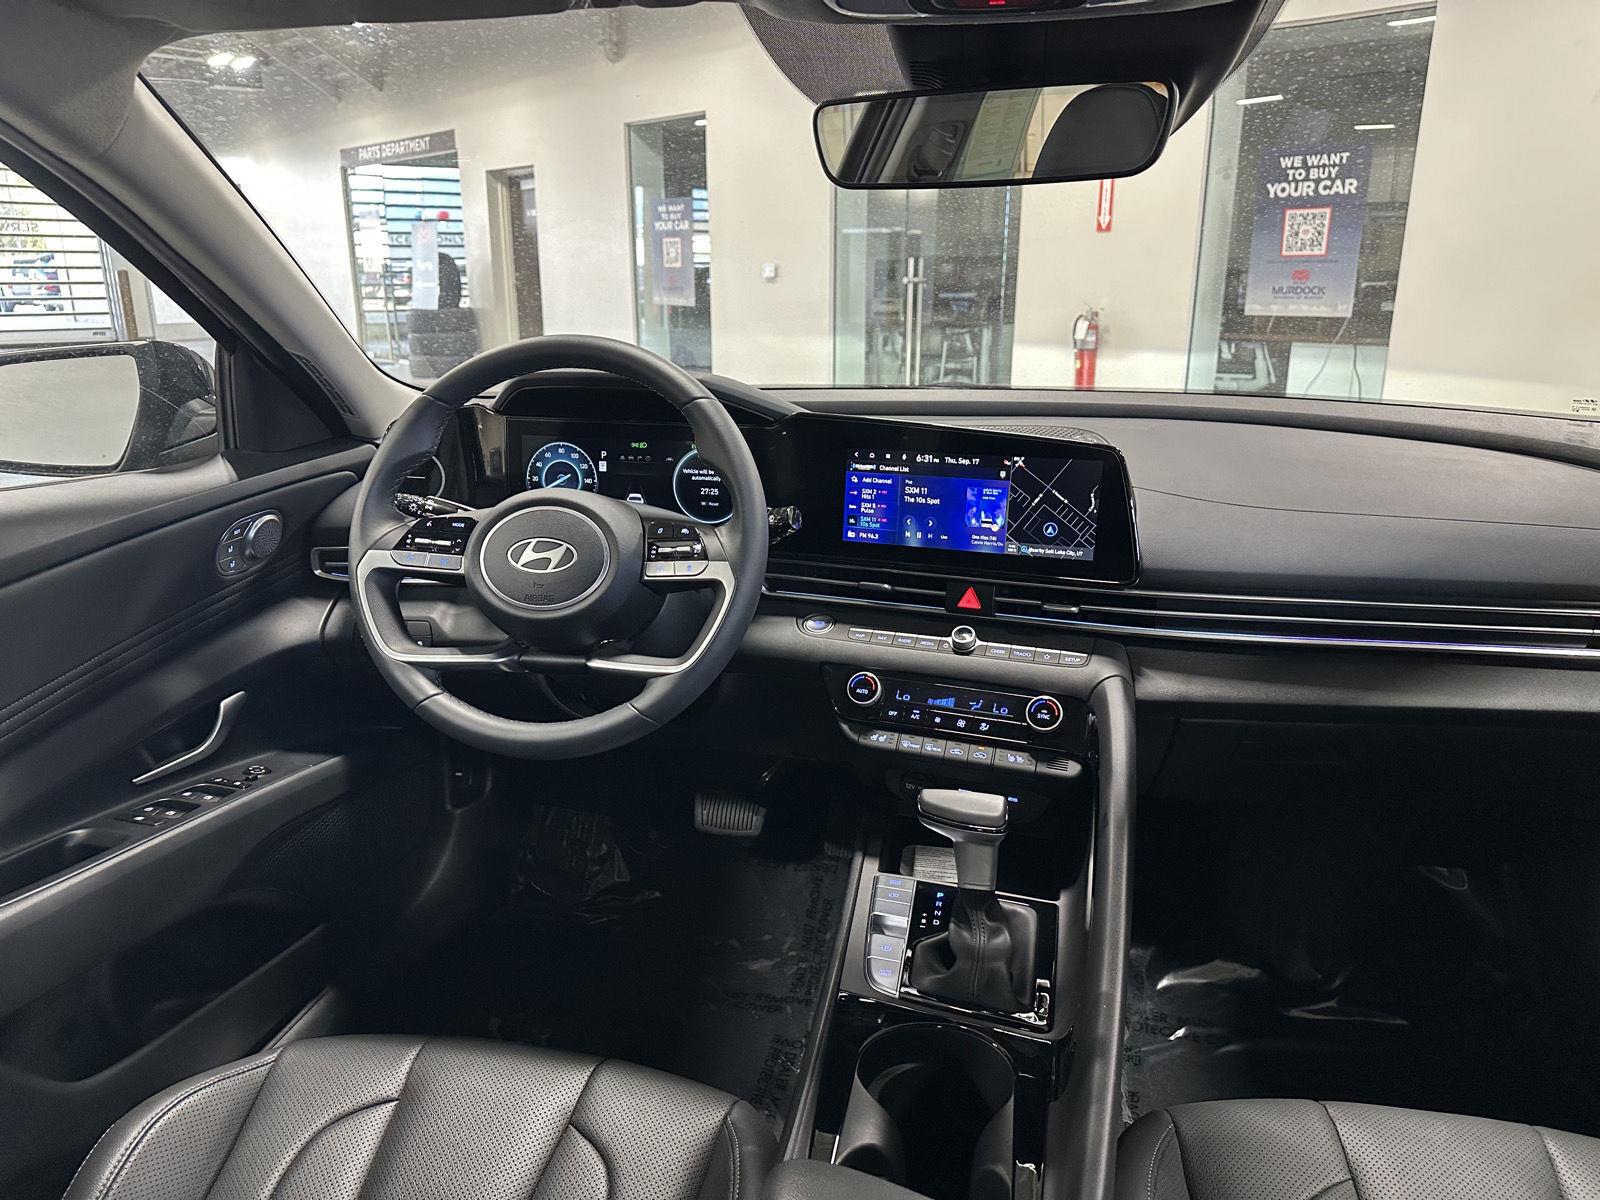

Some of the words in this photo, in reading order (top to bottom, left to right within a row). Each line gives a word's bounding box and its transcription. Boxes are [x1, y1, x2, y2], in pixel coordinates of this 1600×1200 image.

[358, 144, 381, 160] PARTS
[381, 136, 430, 157] DEPARTMENT
[1280, 156, 1303, 168] WE
[1306, 152, 1350, 166] WANT
[1286, 169, 1306, 181] TO
[1309, 166, 1339, 179] BUY
[1266, 180, 1315, 198] YOUR
[1318, 178, 1358, 195] CAR
[1271, 285, 1326, 295] MURDOCK
[601, 451, 607, 459] P
[916, 454, 933, 463] 6:31
[905, 486, 920, 494] SXM
[920, 487, 928, 495] 11
[916, 496, 926, 504] 10s
[927, 497, 940, 505] Spot
